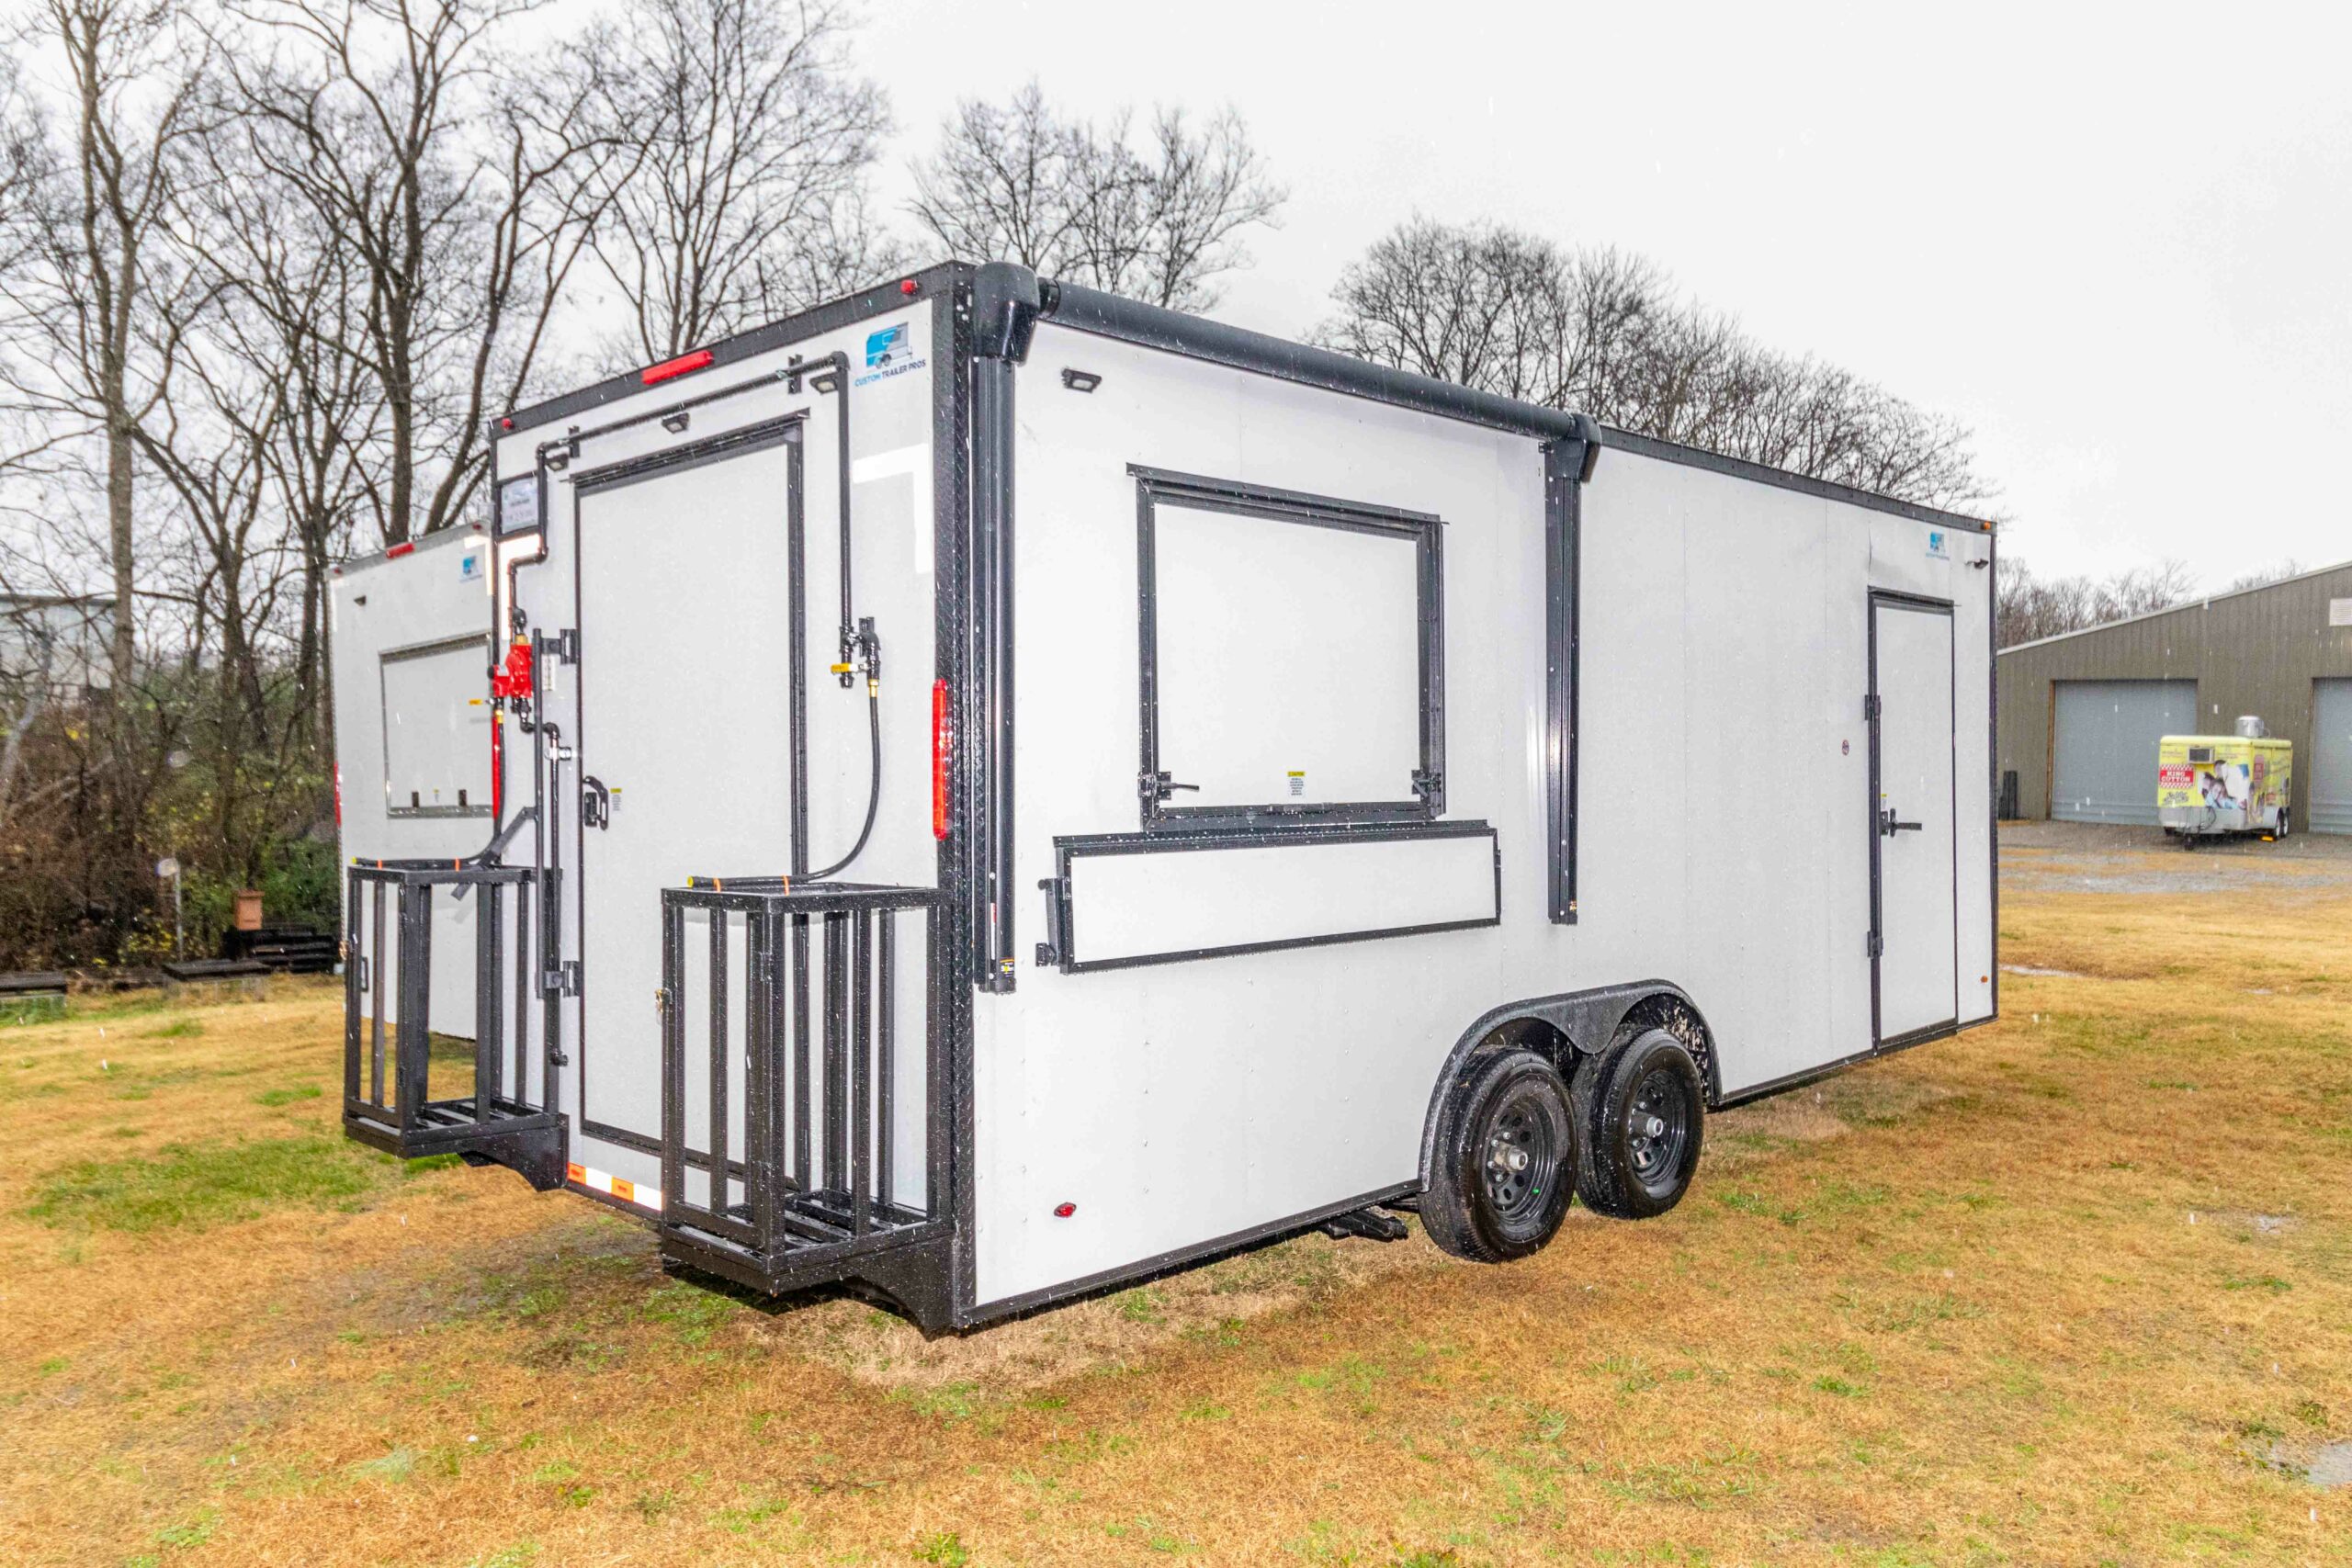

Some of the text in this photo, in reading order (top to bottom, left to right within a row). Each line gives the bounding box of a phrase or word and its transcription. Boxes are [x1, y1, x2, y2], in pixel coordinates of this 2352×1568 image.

[854, 359, 926, 387] CUSTOM TRAILER PROS
